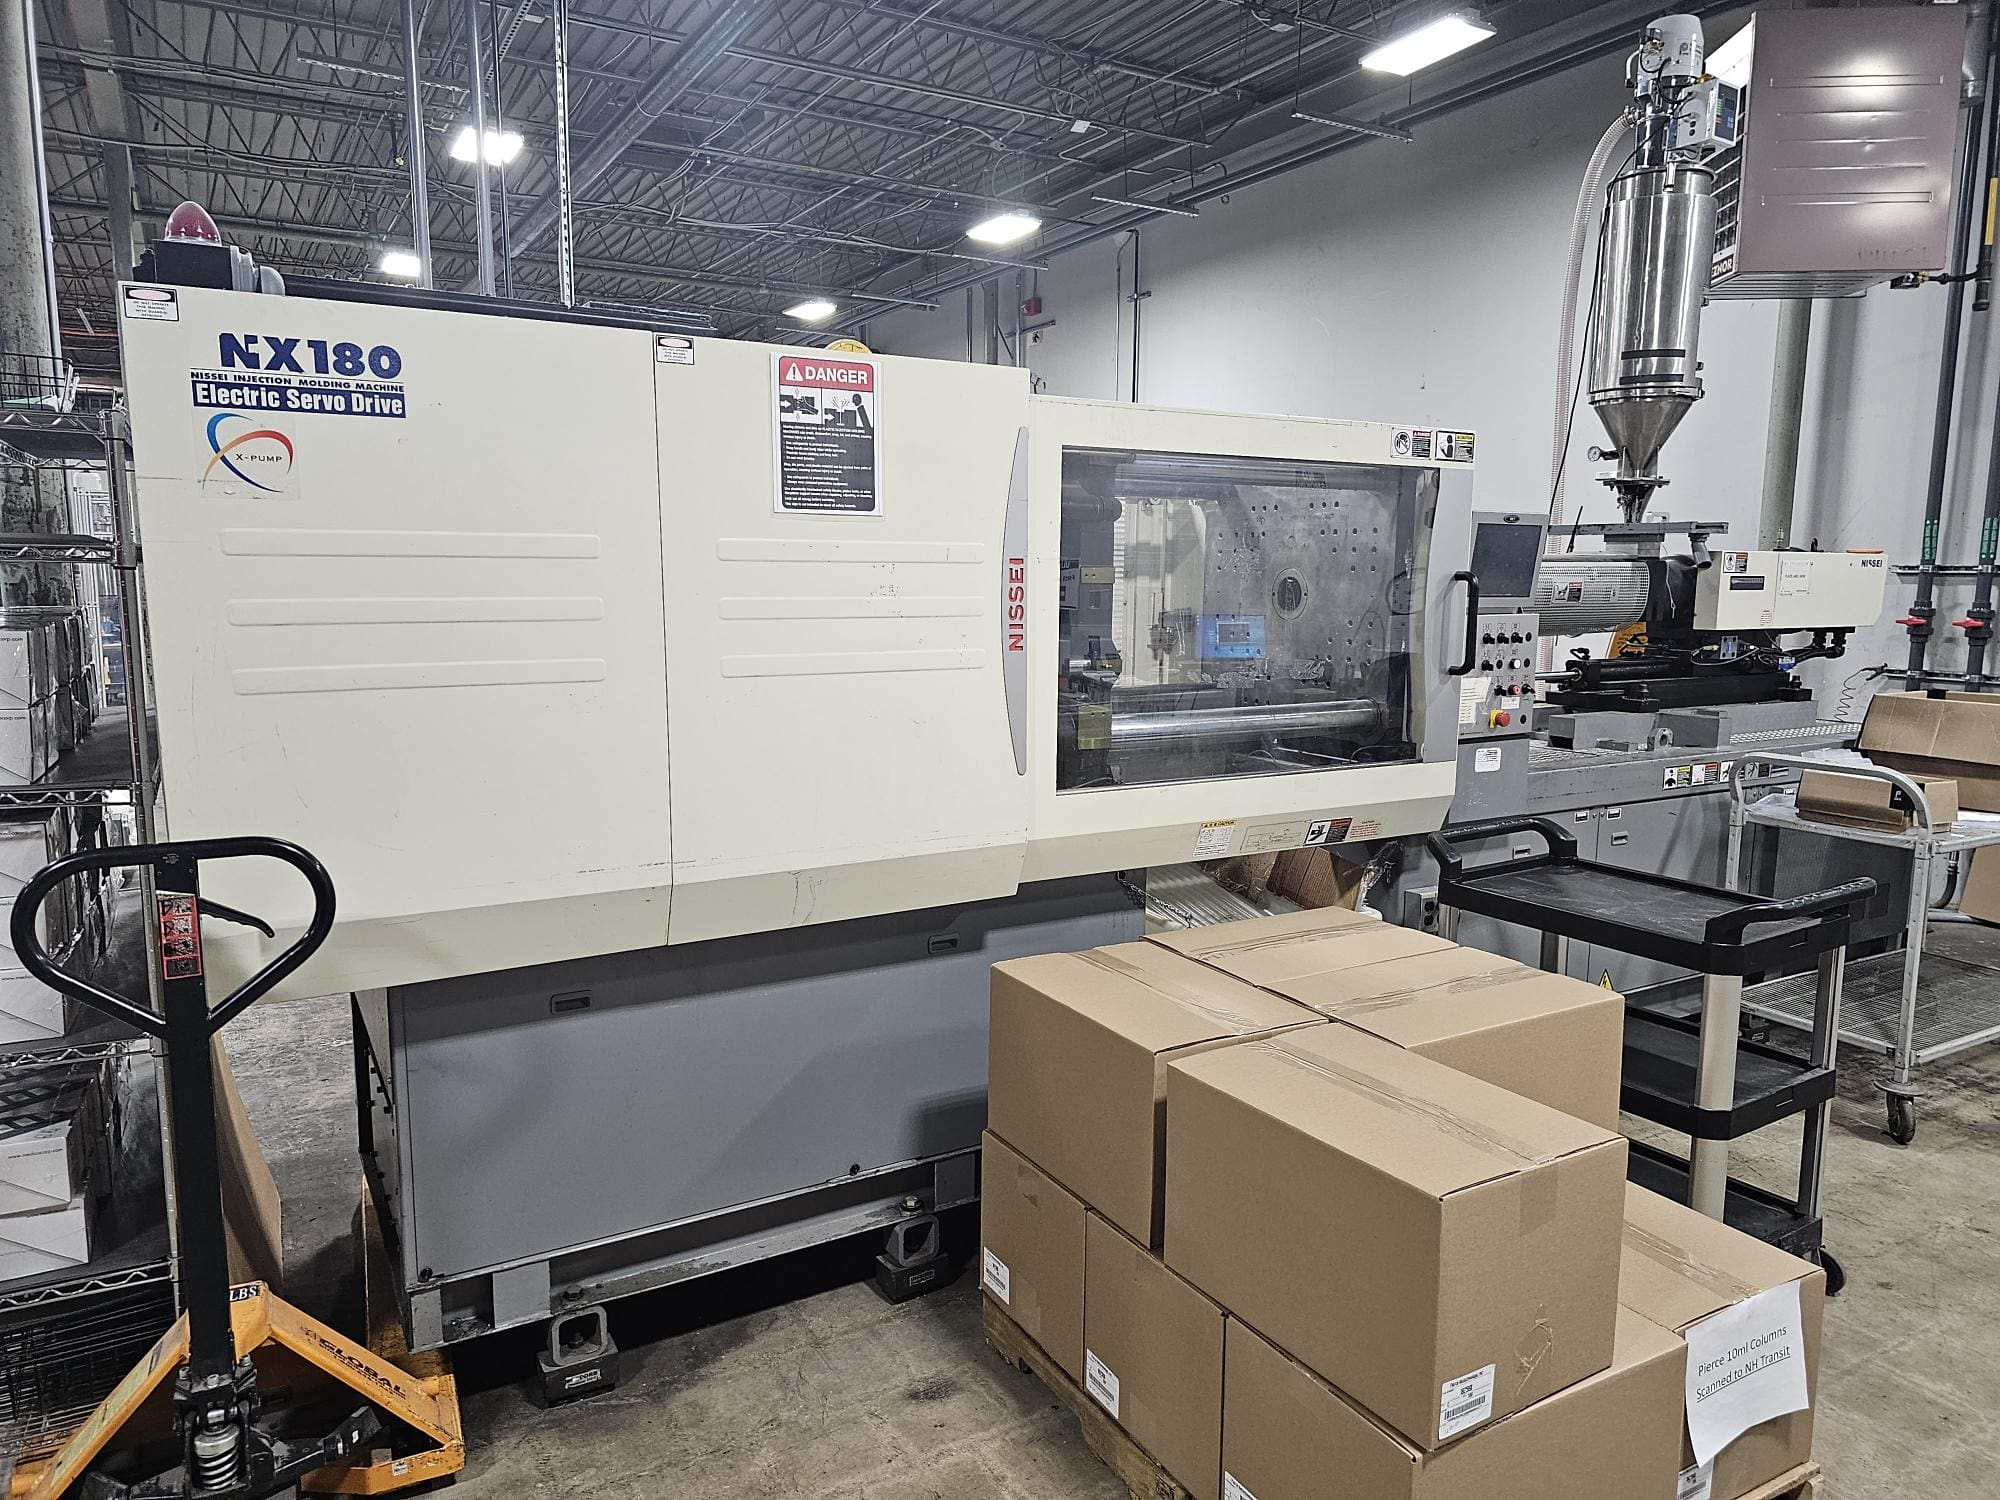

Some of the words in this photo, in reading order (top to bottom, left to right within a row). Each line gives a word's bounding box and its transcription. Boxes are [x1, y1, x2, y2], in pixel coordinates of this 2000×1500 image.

[219, 332, 402, 379] NX180
[190, 371, 228, 381] NISSEI
[233, 374, 292, 385] INJECTION
[298, 379, 351, 389] MOLDING
[355, 382, 405, 393] MACHINE
[804, 365, 868, 385] DANGER
[195, 382, 280, 408] Electric
[286, 388, 346, 412] Servo
[351, 392, 403, 415] Drive
[235, 453, 282, 463] X-PUMP
[1008, 557, 1024, 652] NISSEI
[229, 1285, 257, 1302] LBS
[1698, 1356, 1725, 1377] Pierce
[1727, 1341, 1748, 1362] 10ml
[1750, 1326, 1787, 1350] Columns
[1696, 1371, 1732, 1400] Scanned
[1734, 1369, 1743, 1380] to
[1745, 1358, 1758, 1374] NH
[1760, 1345, 1791, 1366] Transit
